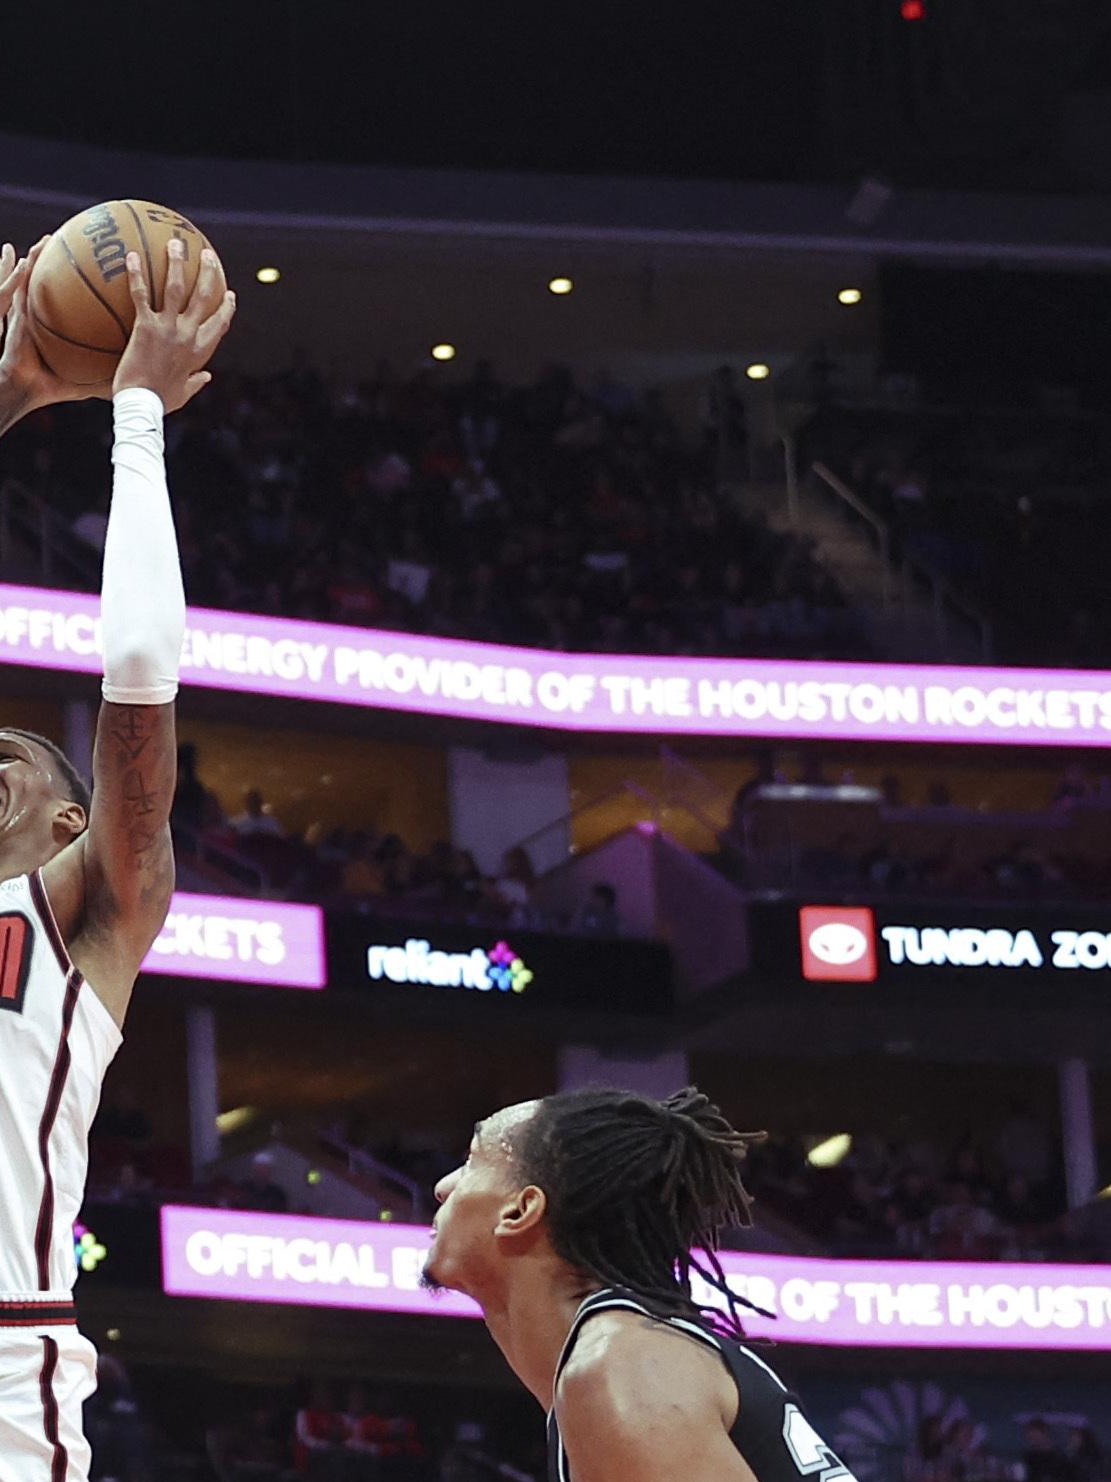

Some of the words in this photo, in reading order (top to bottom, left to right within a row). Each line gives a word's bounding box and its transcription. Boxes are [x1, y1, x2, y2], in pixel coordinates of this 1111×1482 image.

[334, 647, 532, 707] PROVIDER
[537, 672, 594, 713] OF
[601, 675, 691, 717] THE
[697, 679, 919, 724] HOUSTON
[367, 938, 493, 991] reliant
[882, 926, 1044, 968] TUNDRA
[185, 1230, 387, 1288] OFFICIAL
[780, 1277, 841, 1323] OF
[844, 1281, 945, 1327] THE
[947, 1284, 1111, 1329] HOUST
